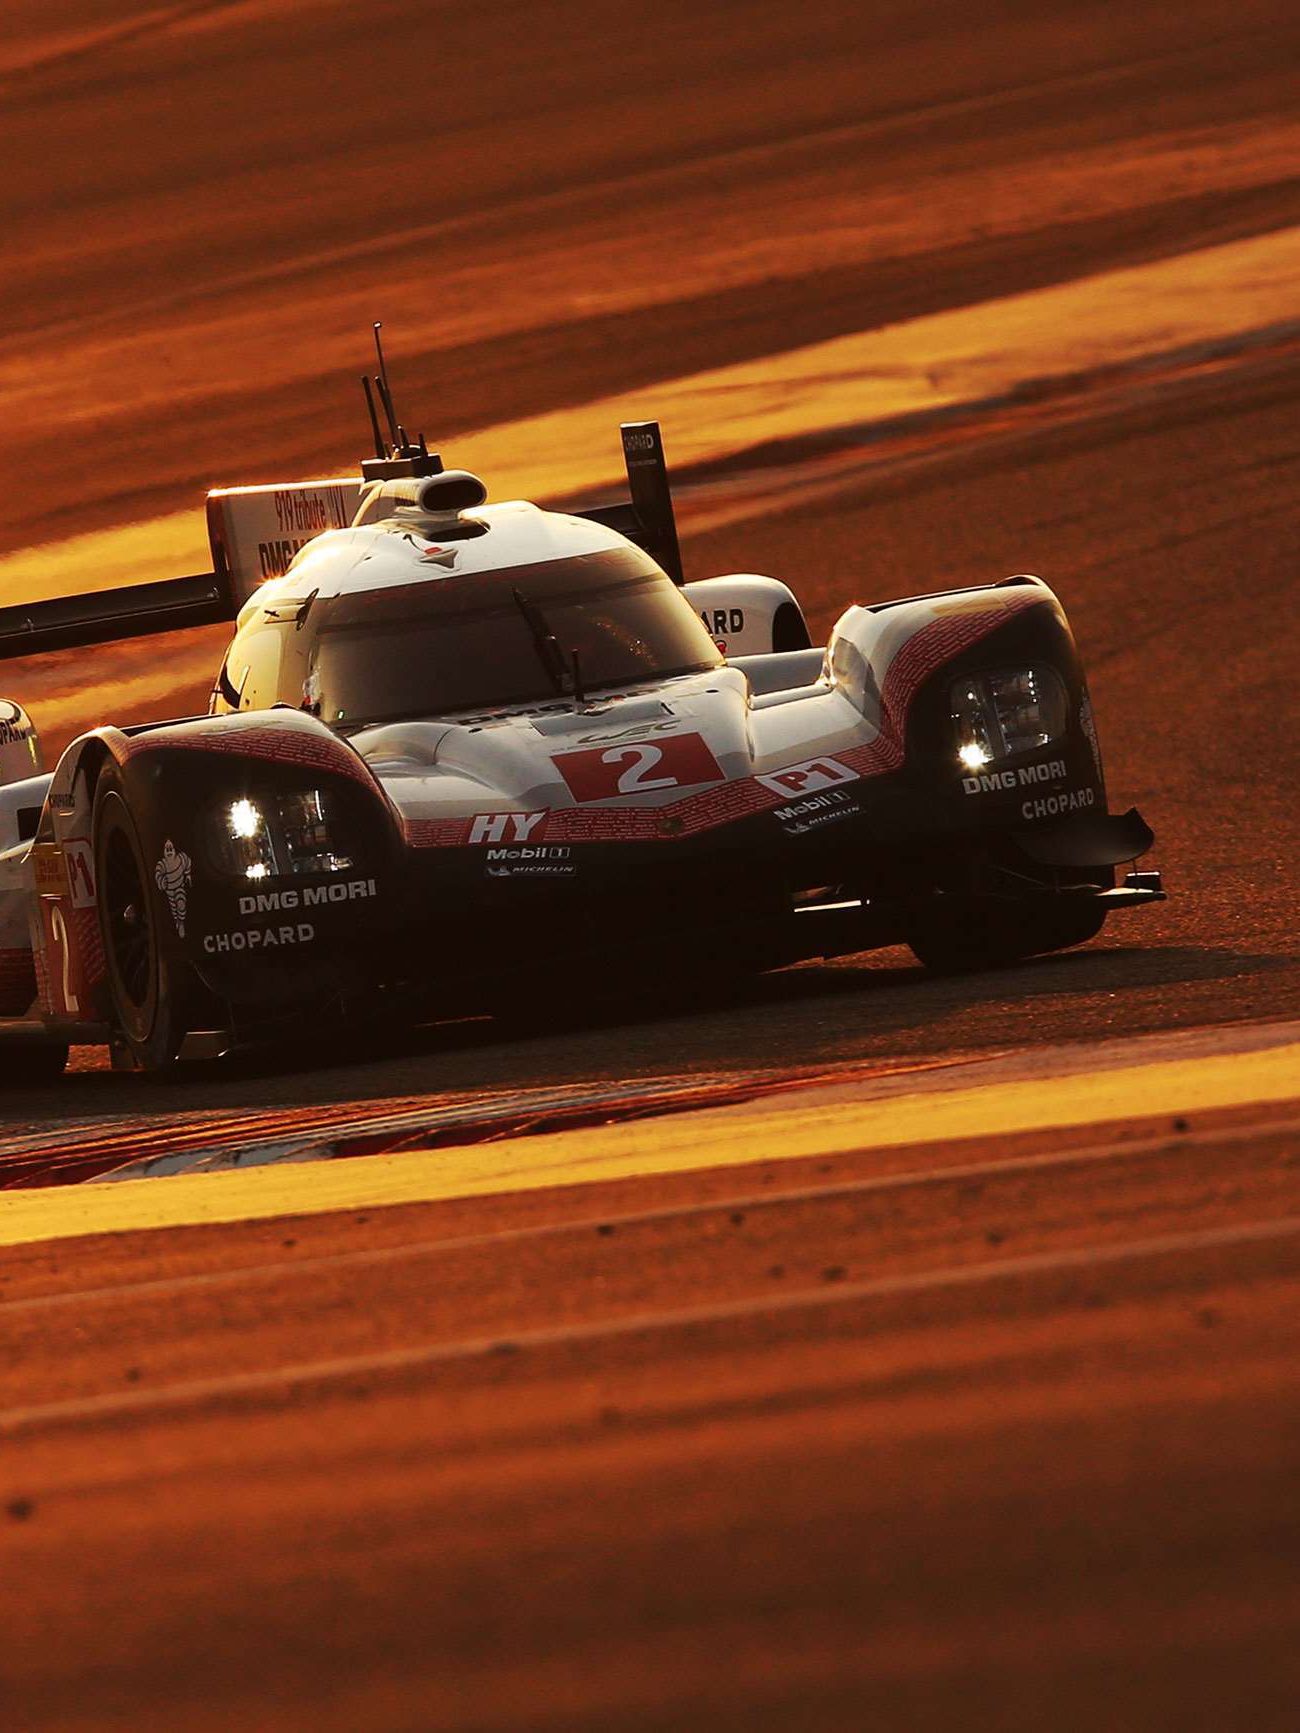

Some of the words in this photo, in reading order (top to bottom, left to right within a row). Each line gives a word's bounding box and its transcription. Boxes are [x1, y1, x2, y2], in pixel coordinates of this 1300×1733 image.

[274, 490, 294, 532] 919
[700, 608, 744, 634] ARD
[601, 744, 679, 794] 2
[771, 762, 844, 792] P1
[961, 770, 1017, 795] DMG
[1017, 759, 1068, 785] MORI
[772, 794, 833, 821] Mobil
[1021, 786, 1095, 820] CHOPARD
[467, 811, 548, 844] HY
[486, 847, 547, 860] Mobil
[512, 865, 574, 873] MICHELIN
[238, 890, 299, 915] DMG
[302, 879, 378, 906] MORI
[203, 922, 316, 953] CHOPARD
